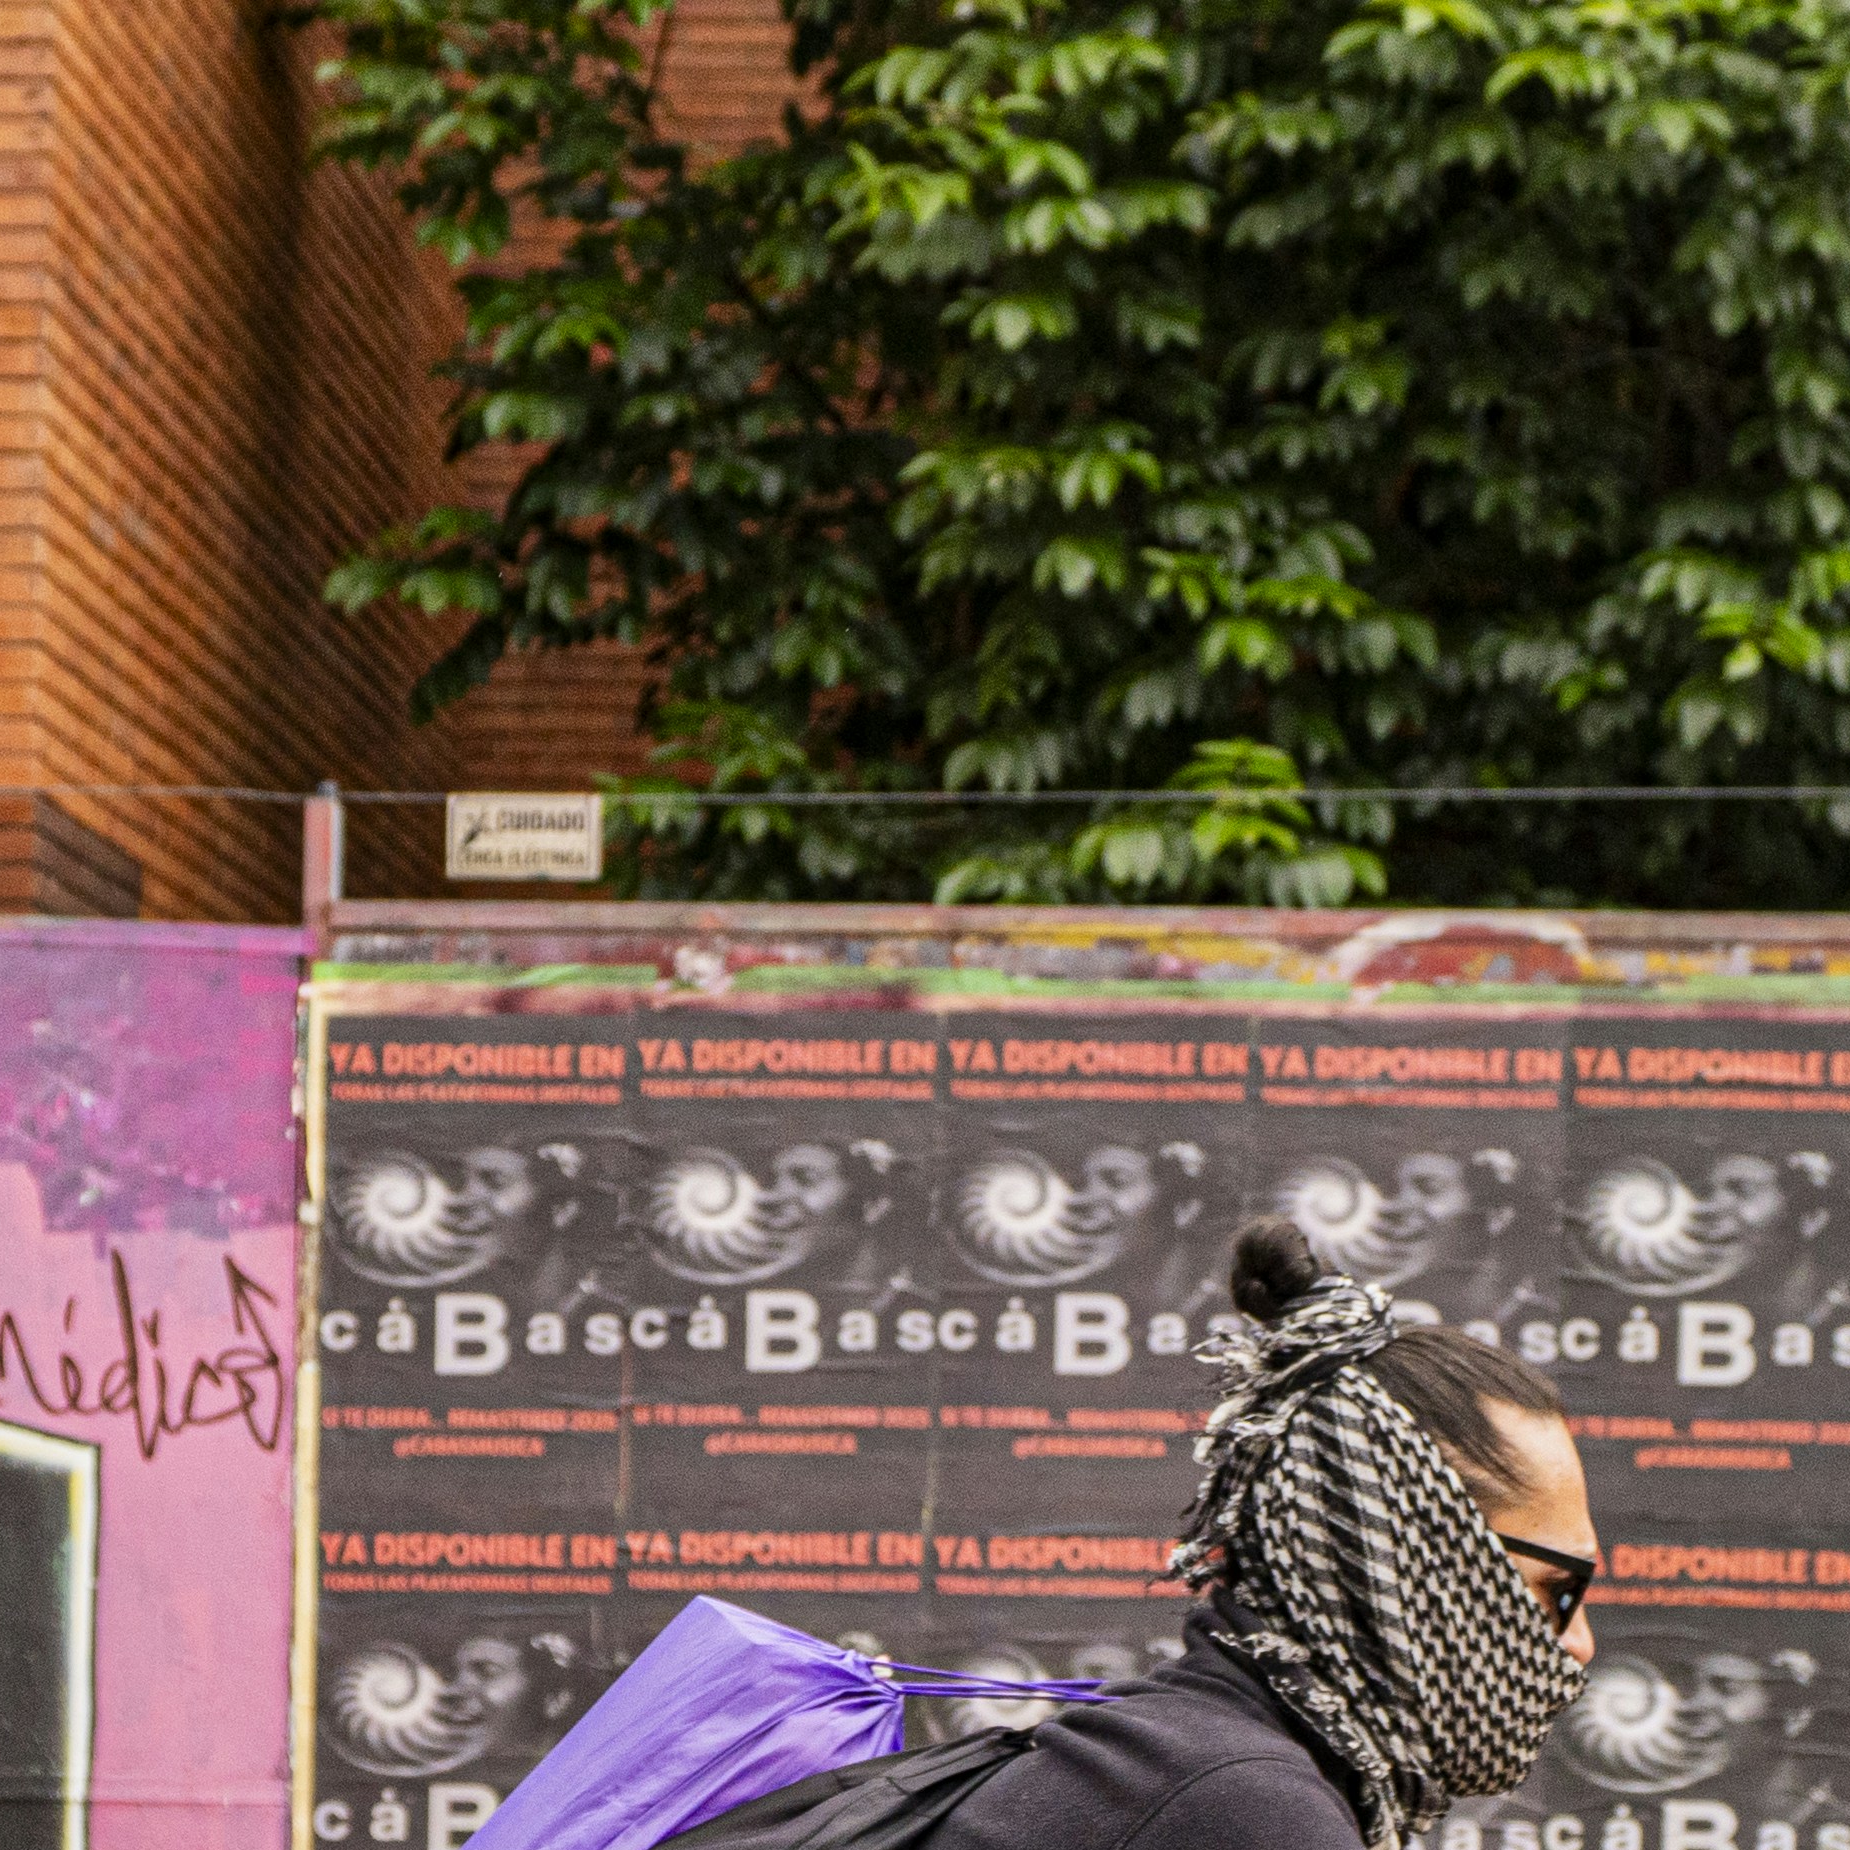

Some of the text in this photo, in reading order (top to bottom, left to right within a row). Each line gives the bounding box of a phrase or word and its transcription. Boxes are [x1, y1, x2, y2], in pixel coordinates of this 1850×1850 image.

[329, 1043, 625, 1077] YA DISPONIBLE EN
[638, 1039, 937, 1073] YA DISPONIBLE EN
[949, 1039, 1249, 1076] YA DISPONIBLE EN
[1260, 1047, 1562, 1082] YA DISPONIBLE EN
[1575, 1048, 1621, 1078] YA
[1628, 1048, 1824, 1085] DISPONIBLE
[320, 1532, 617, 1568] YA DISPONIBLE EN
[626, 1531, 924, 1566] YA DISPONIBLE EN
[934, 1536, 982, 1568] YA
[1611, 1544, 1808, 1583] DISPONIBLE
